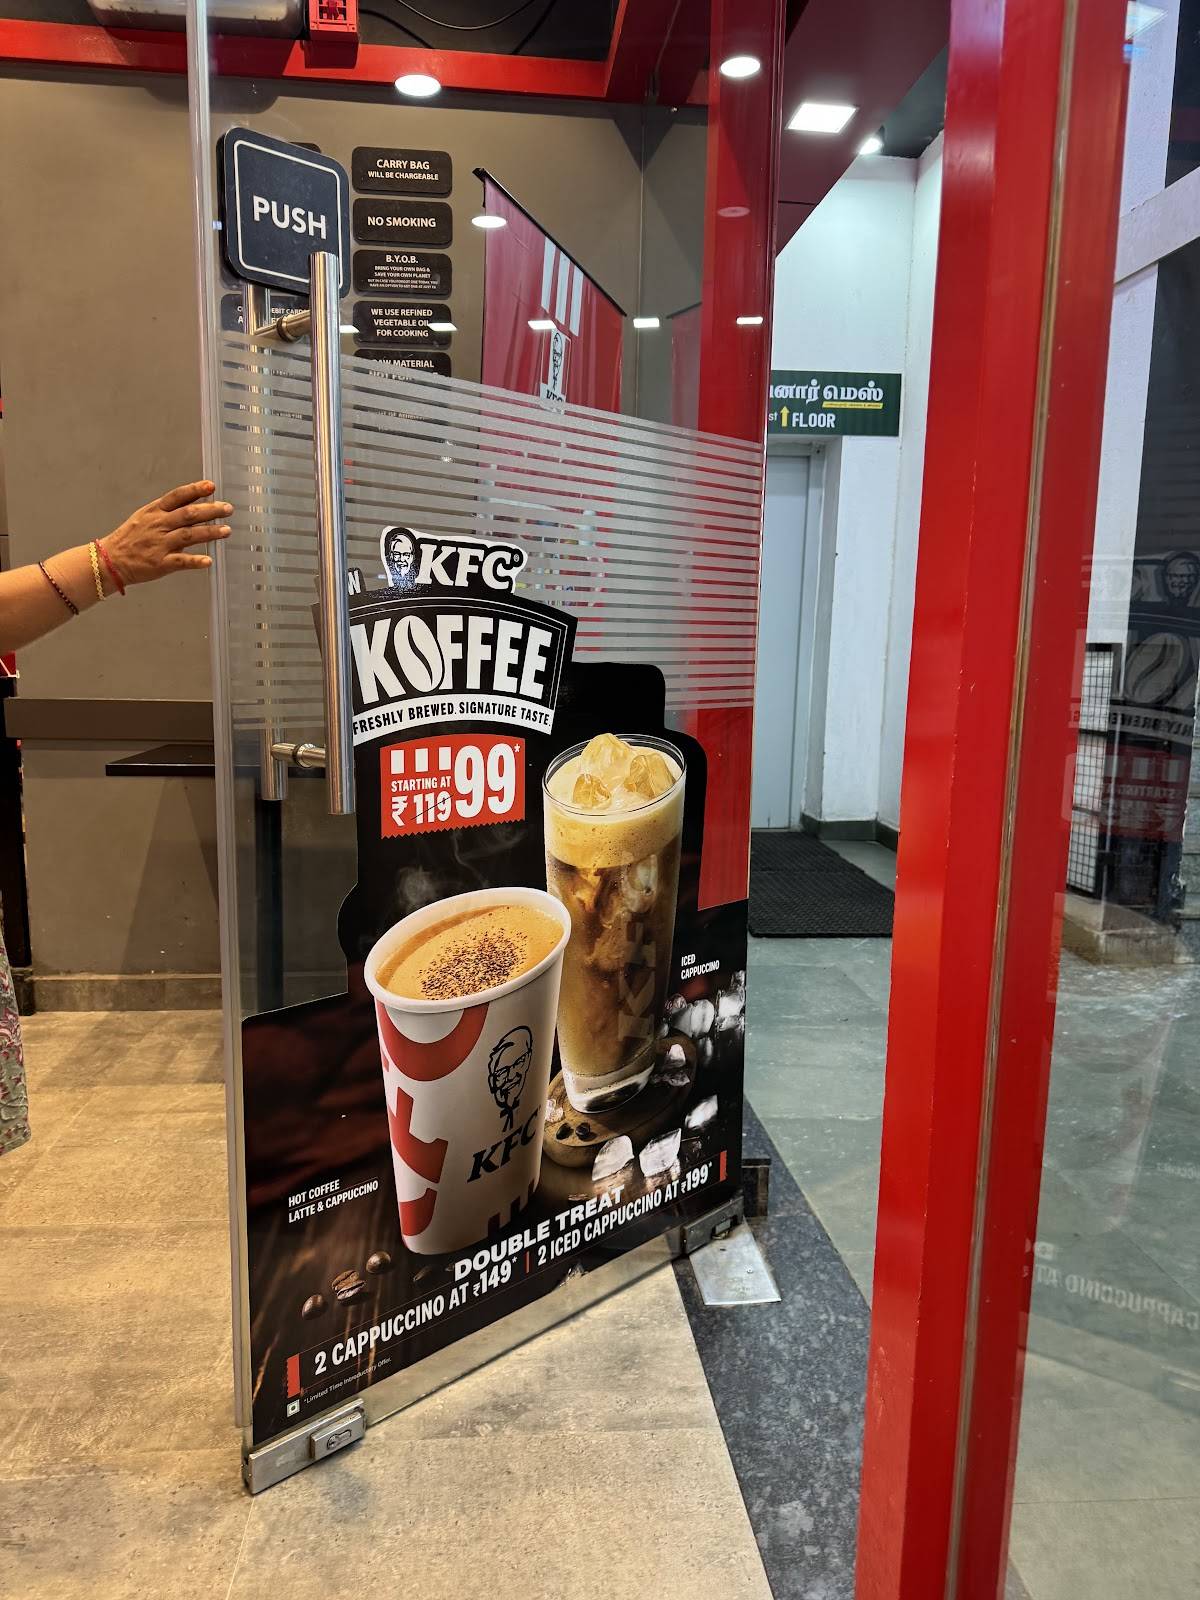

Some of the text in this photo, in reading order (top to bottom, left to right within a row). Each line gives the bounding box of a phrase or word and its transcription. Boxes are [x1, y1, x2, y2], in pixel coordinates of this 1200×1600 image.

[376, 159, 430, 170] CARRY BAG
[395, 172, 439, 181] CHARGEABLE
[252, 194, 327, 240] PUSH
[367, 216, 436, 228] NO SMOKING
[385, 254, 419, 264] B.Y.O.B.
[371, 308, 383, 316] WE
[401, 309, 433, 317] REFINED
[374, 319, 417, 327] VEGETABLE
[394, 360, 434, 368] MATERIAL
[770, 379, 884, 405] னார் மெஸ்
[768, 412, 836, 428] st FLOOR
[350, 614, 552, 705] KOFFEE
[353, 702, 552, 736] FRESHLY BREWED. SIGNATURE TASTE.
[391, 775, 452, 793] STARTING AT
[681, 954, 696, 967] ICED
[681, 960, 720, 980] CAPPUCCINO
[467, 1104, 542, 1183] KFC
[288, 1179, 340, 1208] HOT COFFEE
[289, 1180, 379, 1224] LATTE & CAPPUCCINO
[538, 1243, 547, 1267] 2
[550, 1226, 581, 1261] ICED
[584, 1190, 662, 1243] CAPPUCCINO
[664, 1179, 680, 1203] AT
[454, 1185, 626, 1282] DOUBLE TREAT
[314, 1351, 328, 1376] 2
[332, 1295, 445, 1367] CAPPUCCINO
[448, 1282, 470, 1311] AT
[329, 1381, 344, 1392] Time
